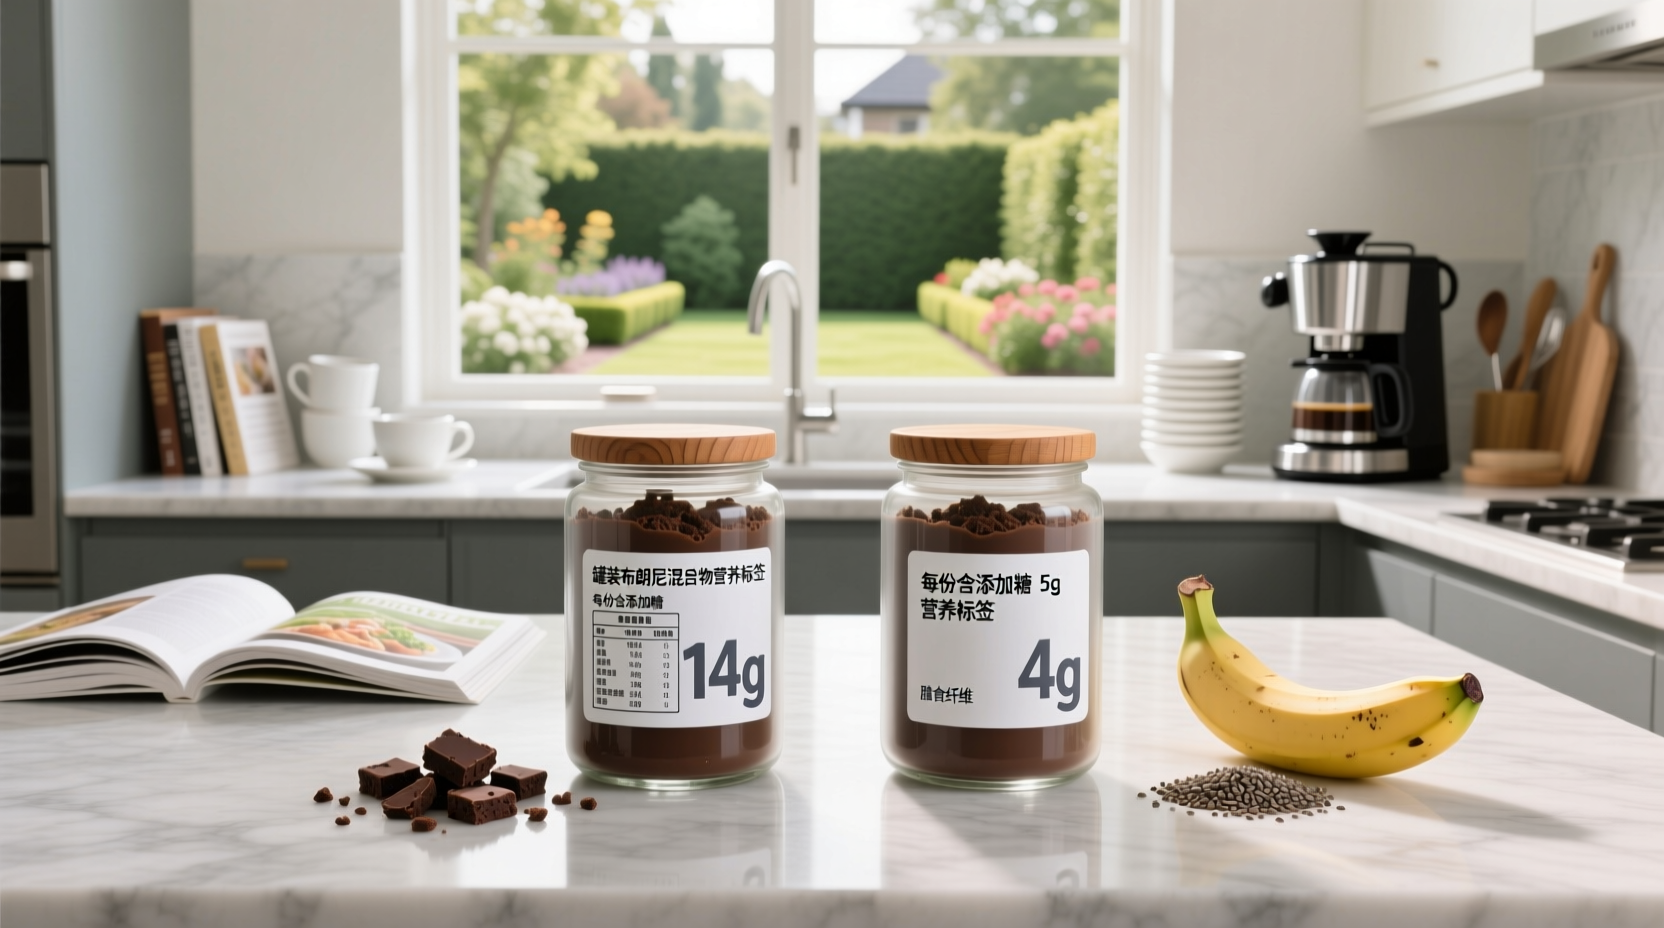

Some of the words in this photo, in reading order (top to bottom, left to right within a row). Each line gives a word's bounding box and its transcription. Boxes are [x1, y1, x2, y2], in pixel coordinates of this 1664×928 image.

[921, 571, 1032, 595] 每份含添加糖
[1040, 574, 1061, 596] 5g
[921, 597, 995, 622] 营养标签
[683, 639, 765, 709] 14g
[1017, 638, 1081, 712] 4g
